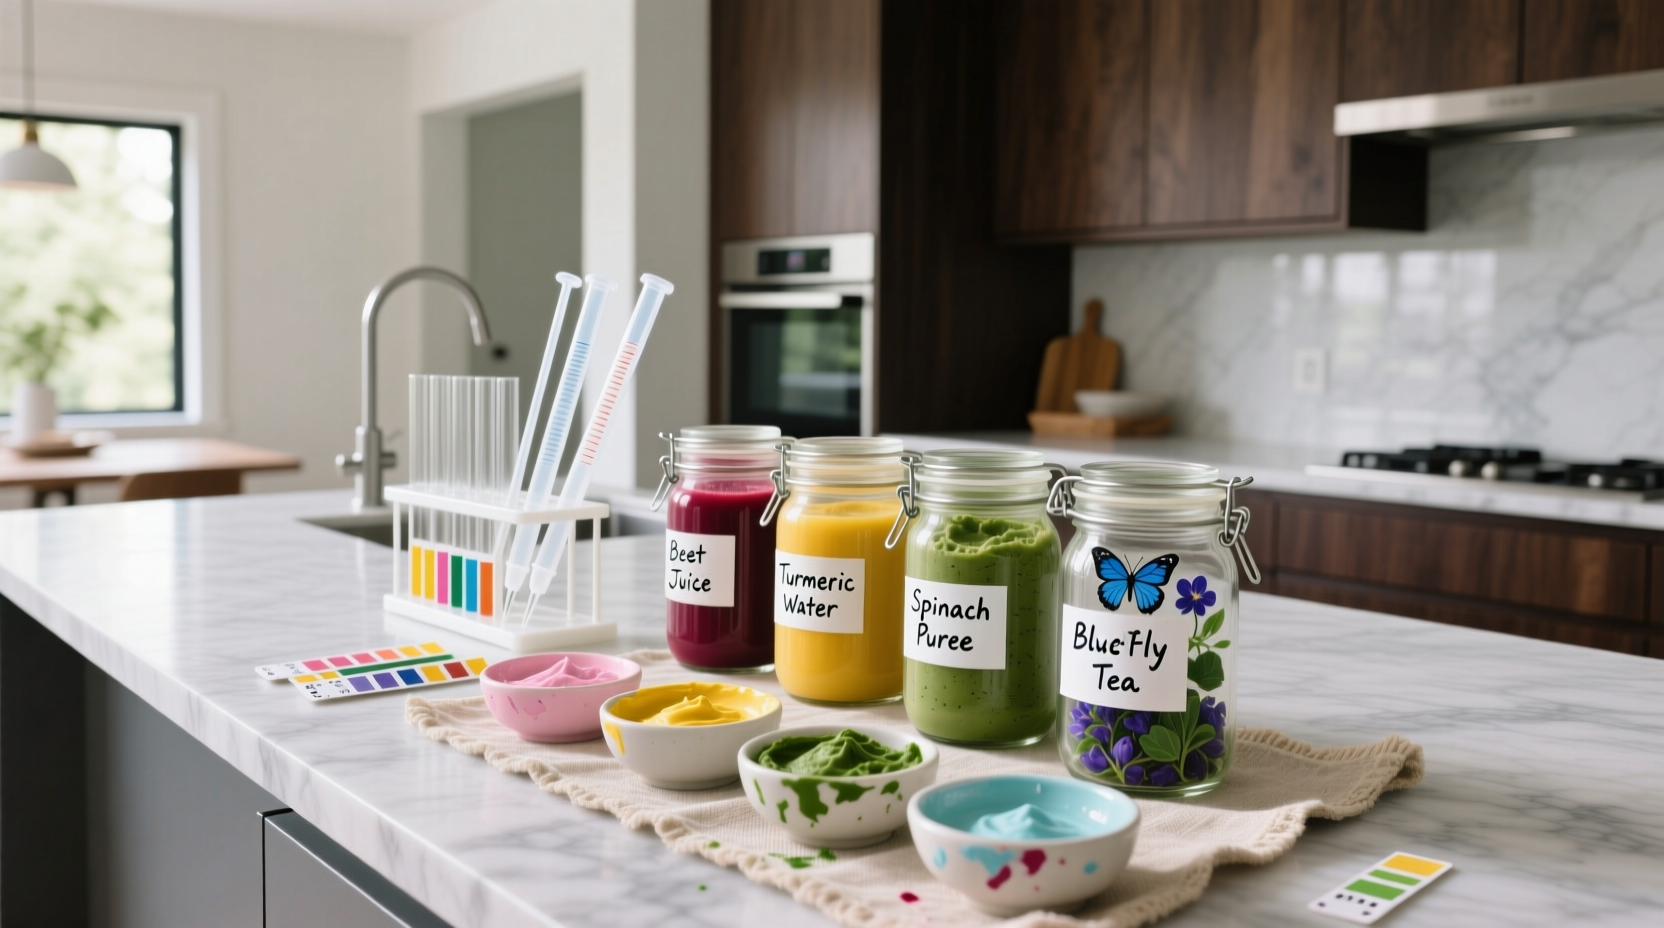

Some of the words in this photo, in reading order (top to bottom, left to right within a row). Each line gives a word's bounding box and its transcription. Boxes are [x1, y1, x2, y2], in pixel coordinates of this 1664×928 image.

[670, 540, 707, 564] Beet
[669, 569, 711, 592] Juice
[779, 563, 855, 592] Turmeric
[783, 594, 838, 618] Water
[911, 588, 990, 621] Spinach
[917, 622, 974, 651] Puree
[1092, 663, 1140, 693] Tea
